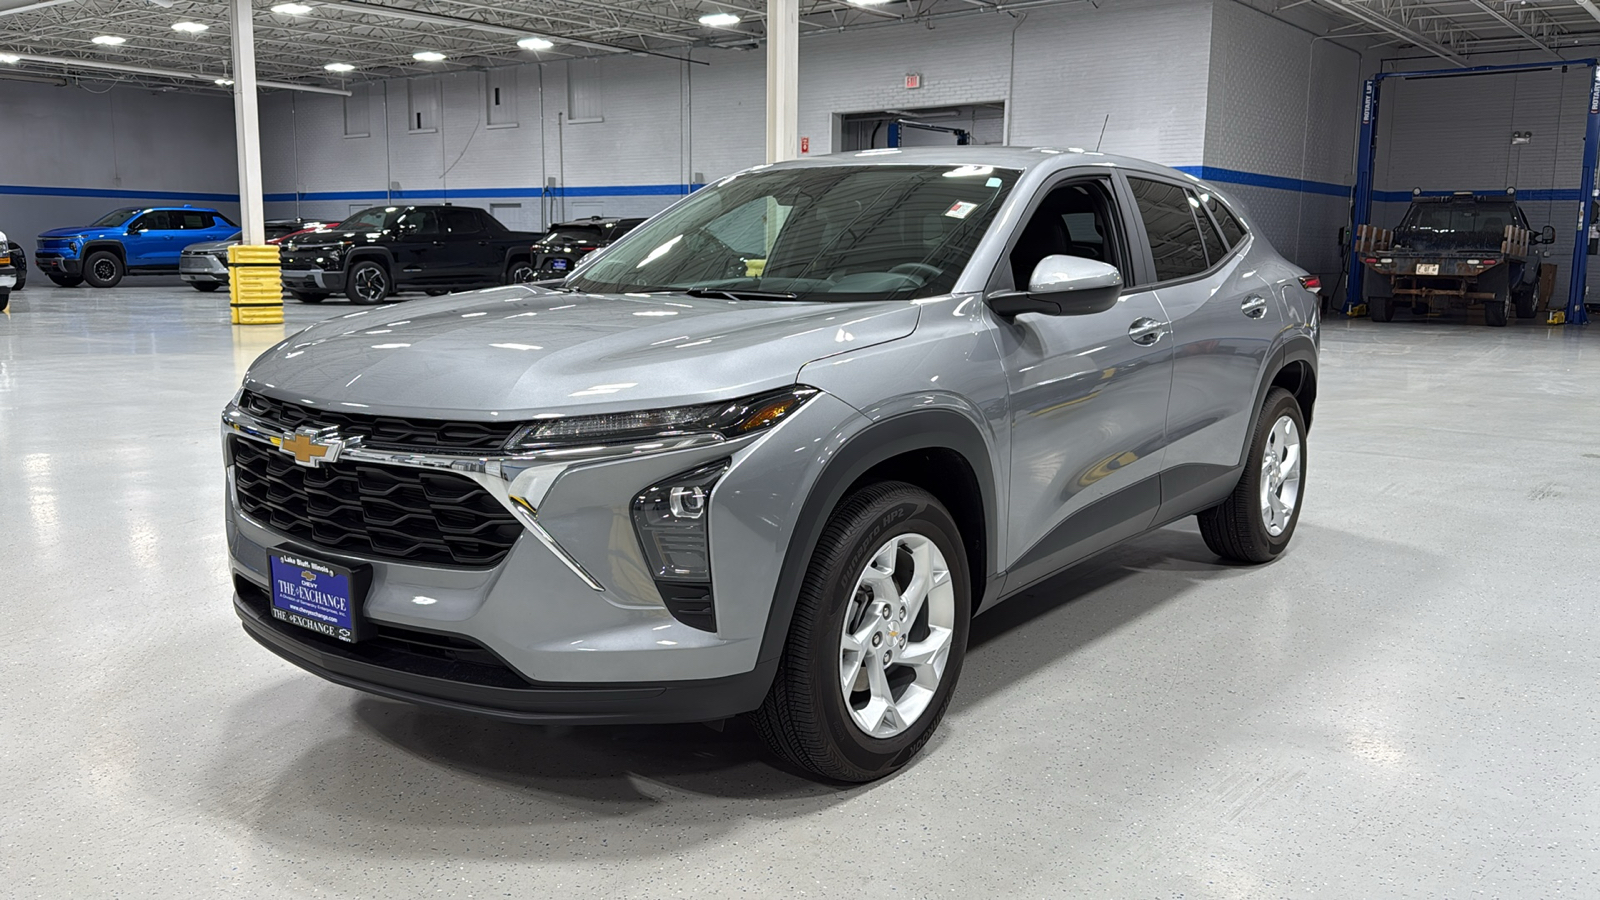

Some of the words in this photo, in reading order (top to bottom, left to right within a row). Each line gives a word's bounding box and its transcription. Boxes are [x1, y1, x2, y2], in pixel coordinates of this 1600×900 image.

[1363, 95, 1372, 121] ROTARY
[882, 507, 904, 528] HP2
[278, 579, 296, 596] THE
[299, 586, 347, 612] EXCHANGE
[301, 580, 318, 588] CHEVY
[272, 608, 287, 620] THE
[292, 614, 335, 636] EXCHANGE
